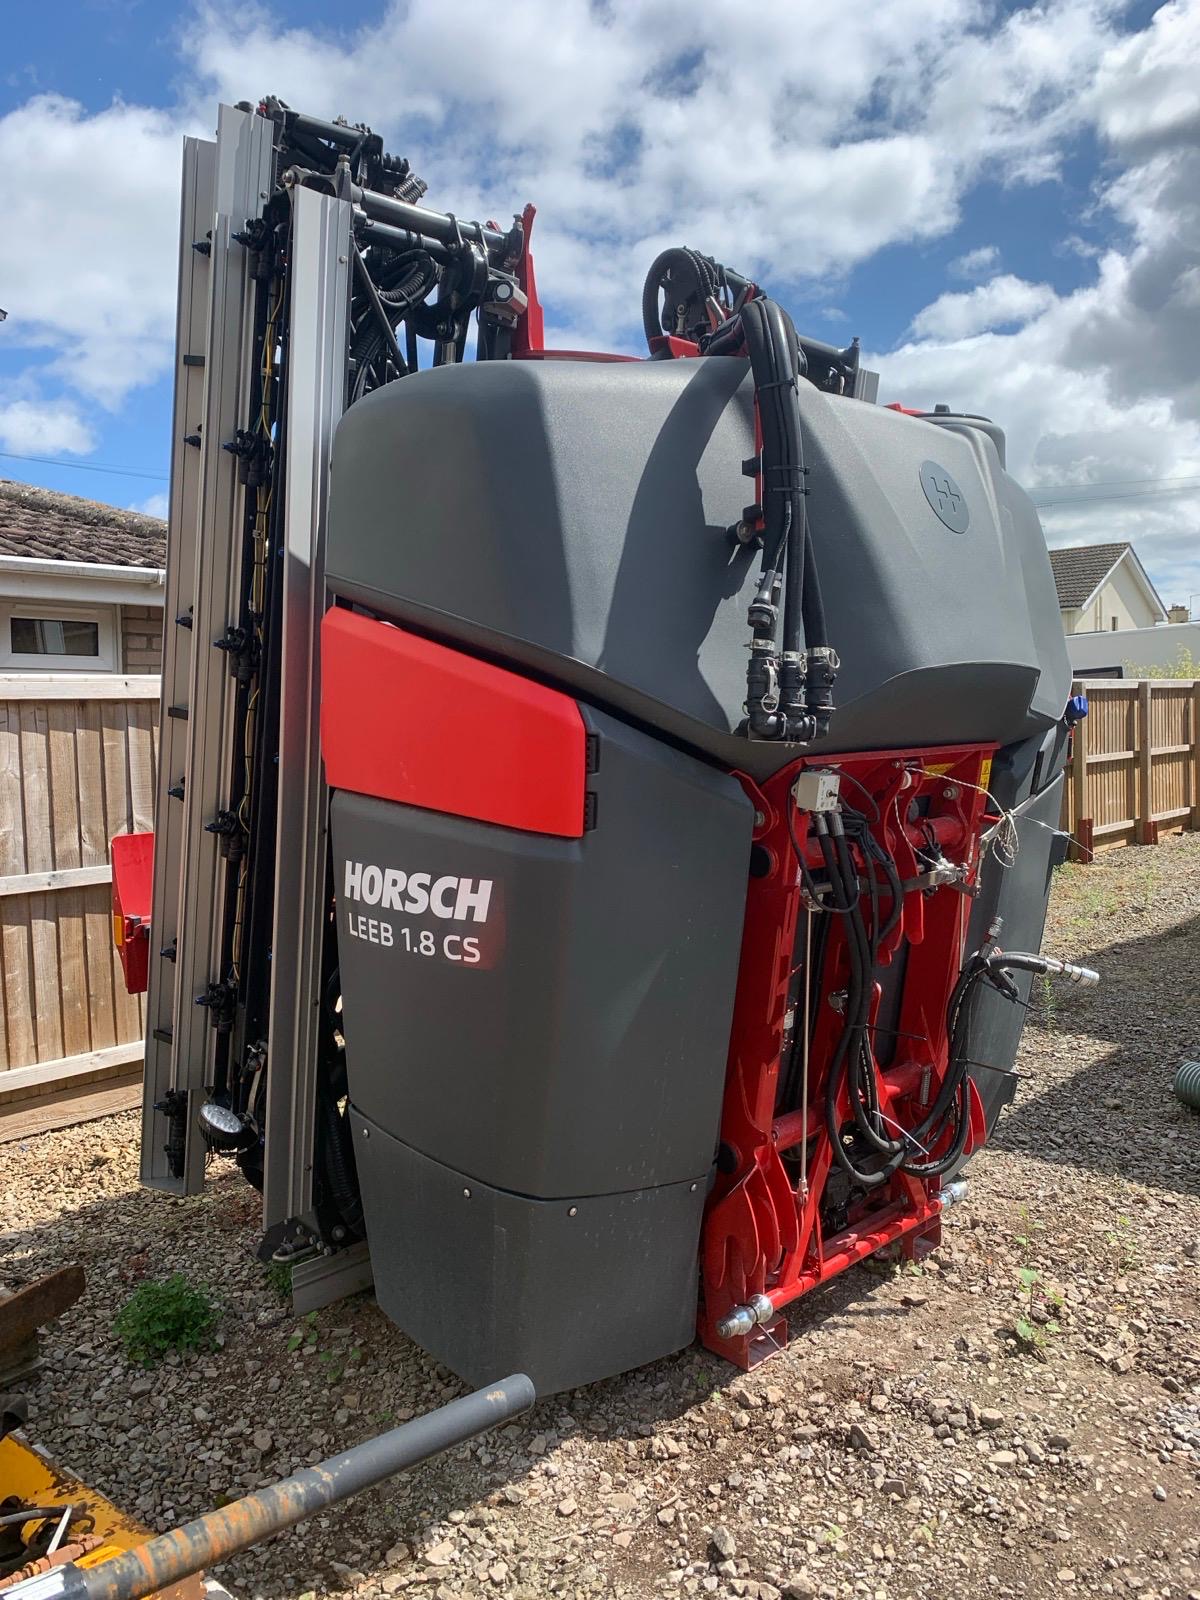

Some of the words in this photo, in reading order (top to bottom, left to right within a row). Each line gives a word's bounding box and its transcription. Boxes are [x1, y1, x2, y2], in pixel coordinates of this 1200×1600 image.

[344, 860, 493, 923] HORSCH
[348, 912, 394, 947] LEEB
[401, 927, 436, 956] 1.8
[443, 934, 481, 963] CS
